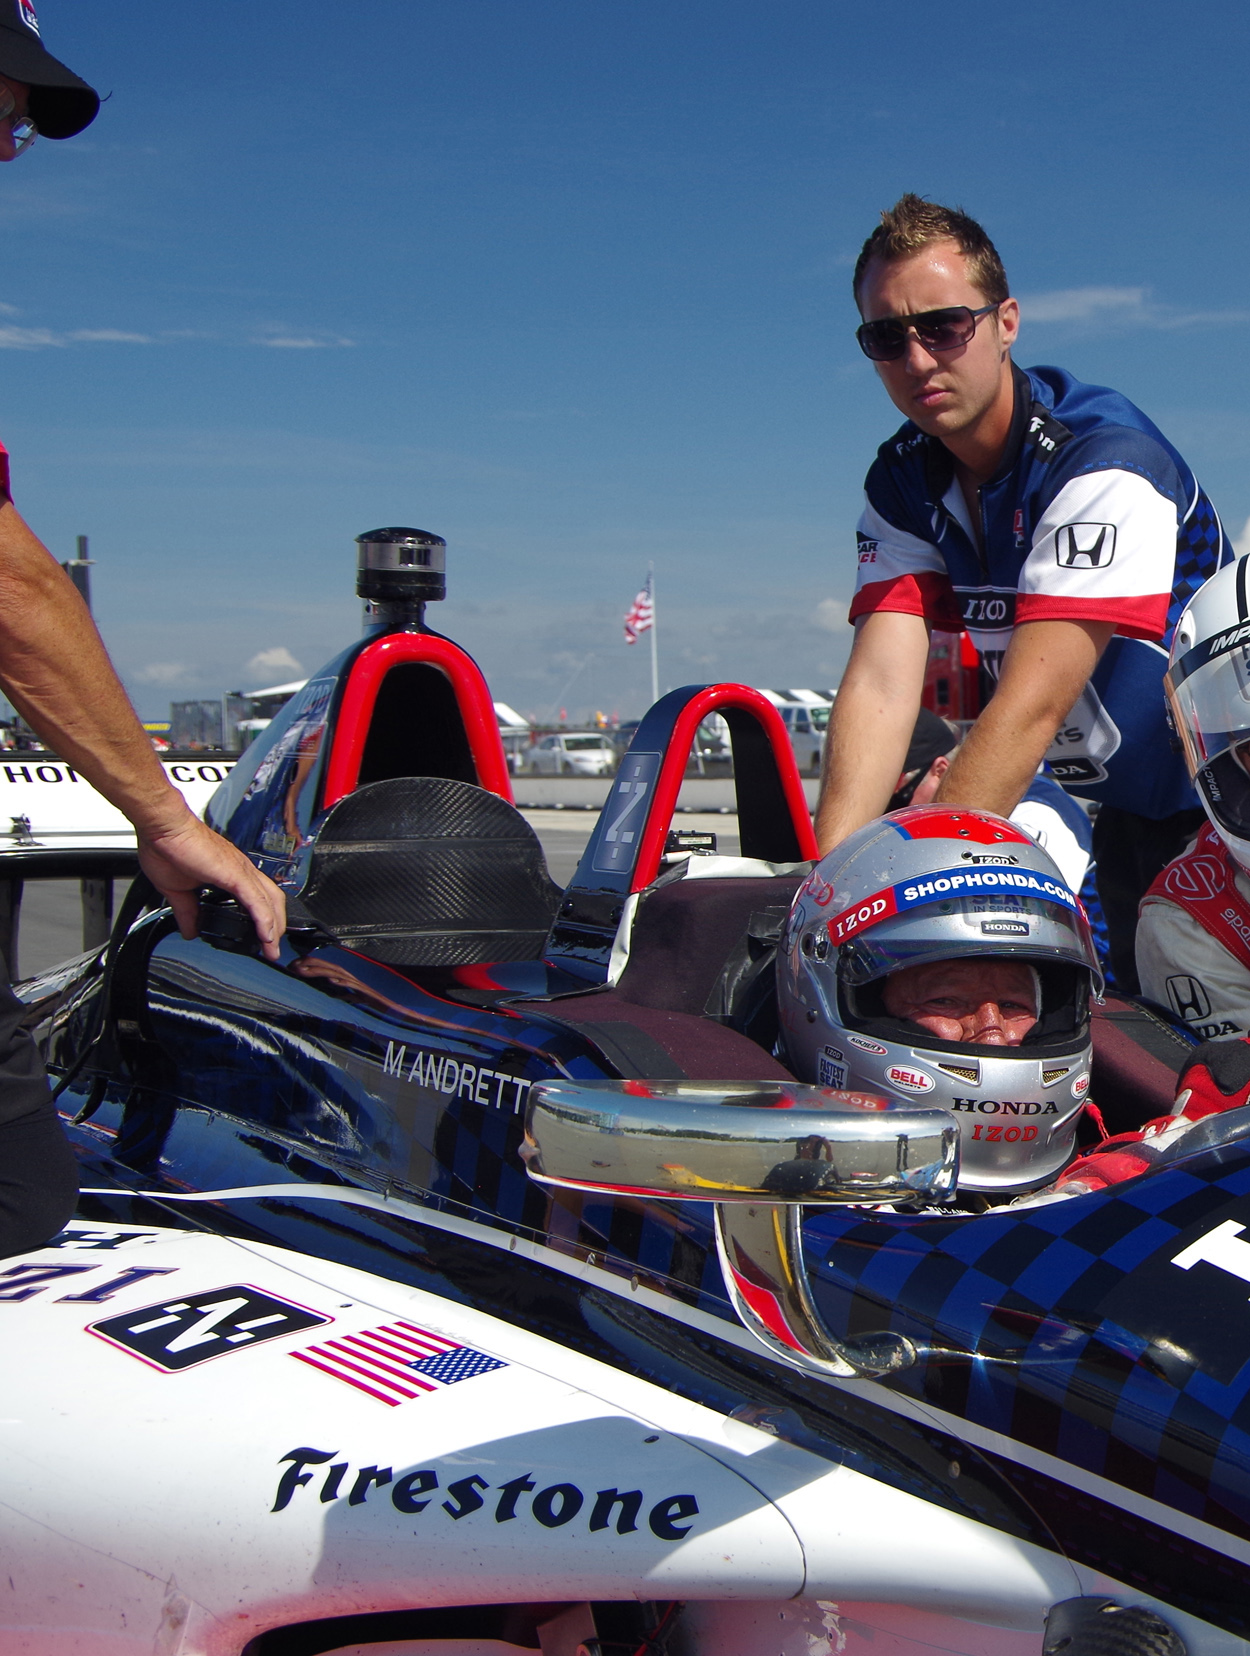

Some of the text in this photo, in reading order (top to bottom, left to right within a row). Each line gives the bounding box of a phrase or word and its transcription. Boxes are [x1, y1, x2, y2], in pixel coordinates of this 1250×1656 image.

[978, 856, 1010, 865] IZOD
[904, 872, 1077, 908] SHOPHONDA.COM
[836, 899, 887, 938] IZOD
[989, 905, 1033, 915] SPORTS
[984, 923, 1028, 933] HONDA
[383, 1041, 532, 1115] M ANDRETT
[820, 1058, 845, 1080] FASTEST
[890, 1068, 928, 1088] BELL
[820, 1074, 843, 1089] SEAT
[951, 1097, 1059, 1115] HONDA
[972, 1124, 1039, 1142] IZOD
[270, 1446, 700, 1541] Firestone
